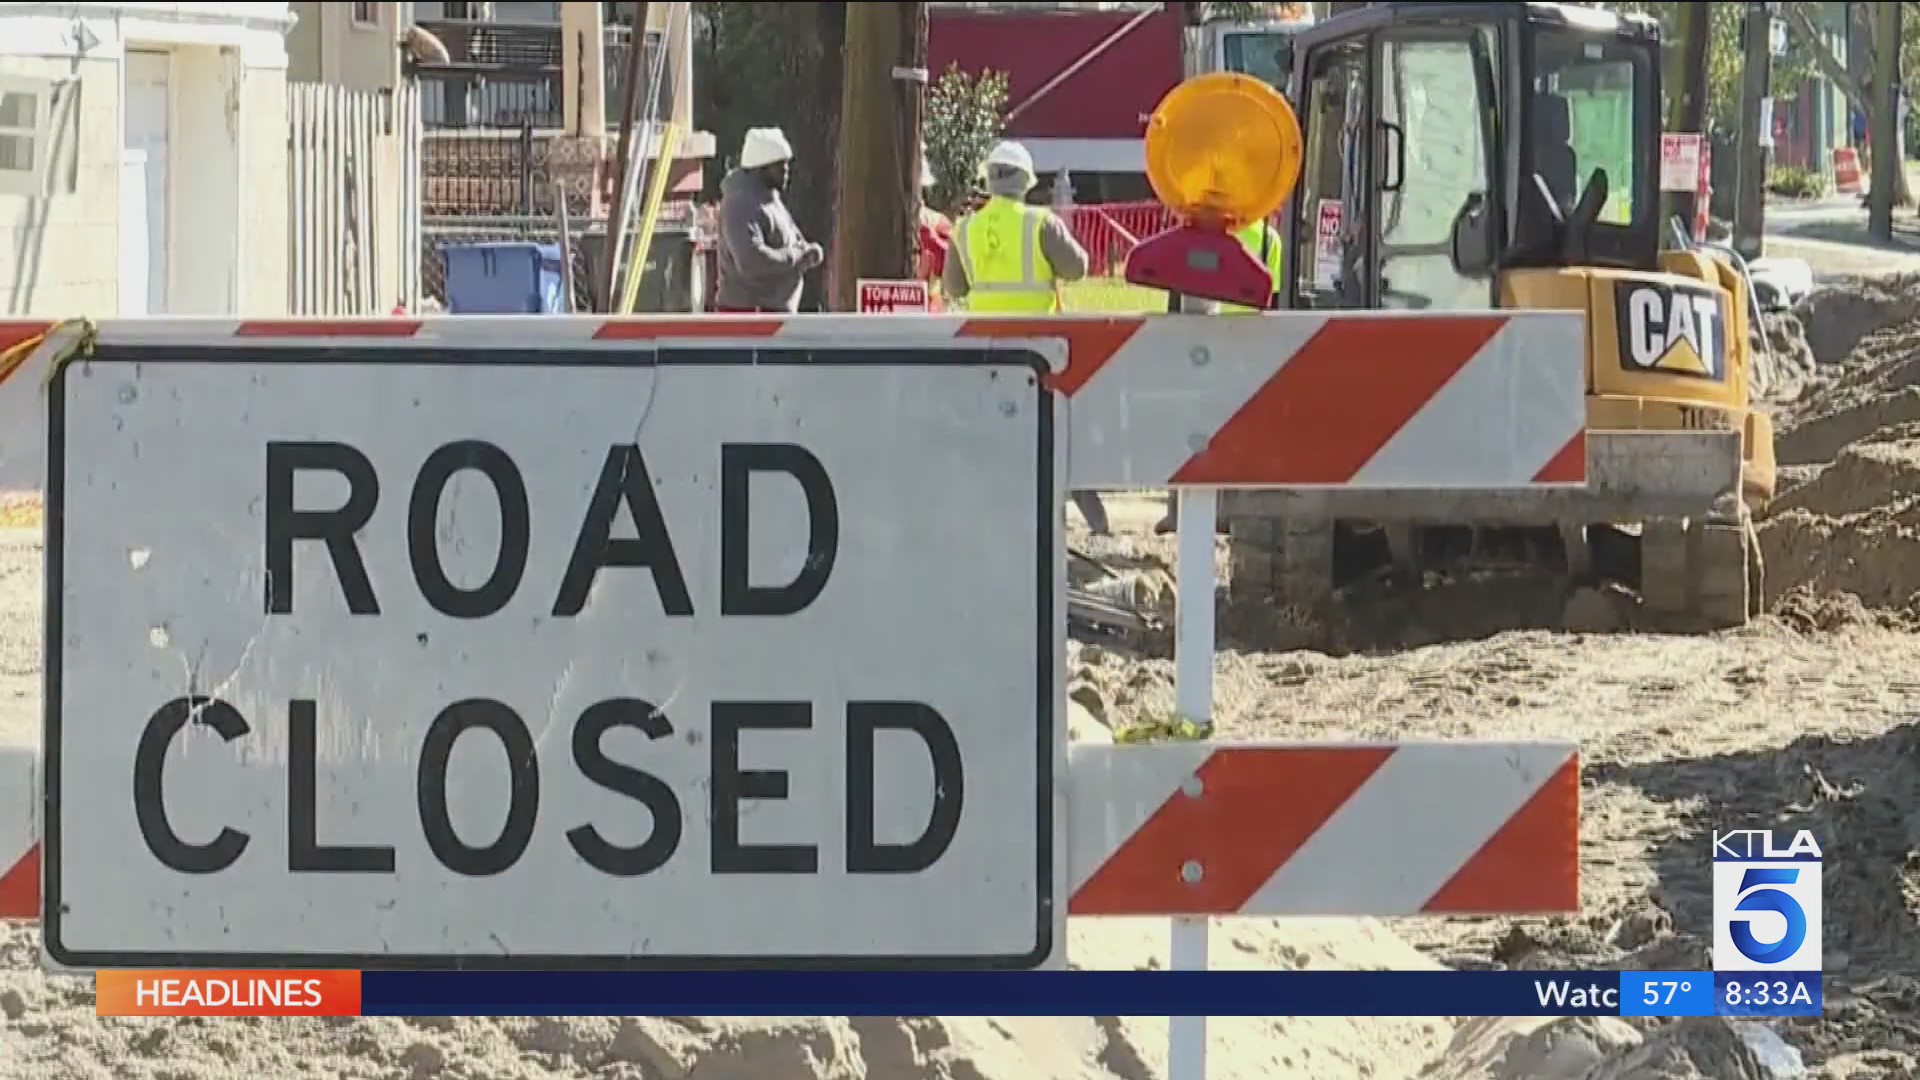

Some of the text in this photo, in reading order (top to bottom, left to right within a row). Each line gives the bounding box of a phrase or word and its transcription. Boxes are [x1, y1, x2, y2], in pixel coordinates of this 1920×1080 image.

[1629, 288, 1717, 376] CAT
[265, 439, 839, 619] ROAD
[133, 697, 965, 876] CLOSED
